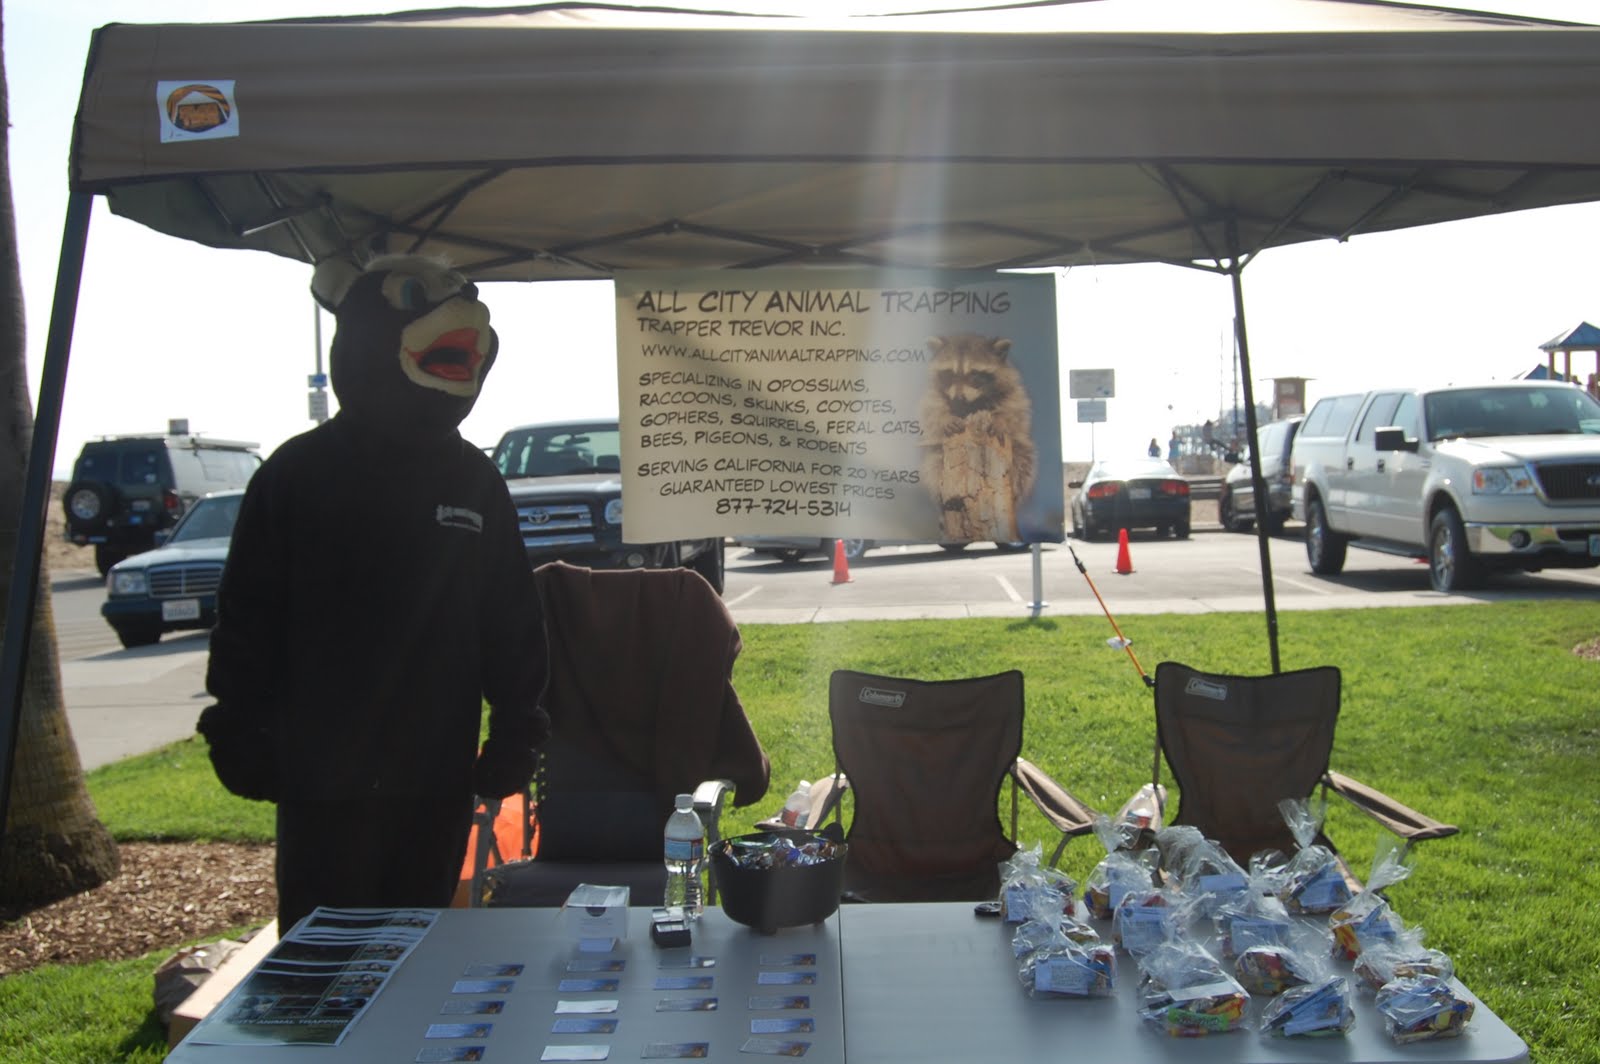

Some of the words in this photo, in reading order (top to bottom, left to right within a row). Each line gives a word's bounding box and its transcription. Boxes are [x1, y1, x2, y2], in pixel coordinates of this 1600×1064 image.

[636, 290, 688, 313] ALL
[698, 290, 758, 313] CITY
[764, 290, 871, 313] ANIMAL
[880, 291, 1012, 314] TRAPPING
[637, 317, 721, 336] TRAPPER
[728, 320, 804, 336] TREVOR
[810, 320, 846, 337] INC.
[641, 344, 925, 364] WWW.ALLCITYANIMALTRAPPING.COM
[639, 371, 742, 389] SPECIALIZING
[748, 379, 762, 392] IN
[767, 379, 870, 393] OPOSSUMS,
[639, 391, 737, 407] RACCOONS,
[743, 397, 809, 414] SKUNKS,
[816, 400, 897, 415] COYOTES,
[640, 411, 724, 427] GOPHERS,
[730, 413, 820, 435] SQUIRRELS,
[826, 420, 875, 434] FERAL
[882, 420, 924, 436] CATS,
[641, 432, 687, 448] BEES,
[694, 431, 773, 447] PIGEONS,
[779, 435, 791, 447] &
[797, 438, 867, 455] RODENTS
[637, 458, 708, 477] SERVING
[714, 458, 805, 474] CALIFORNIA
[811, 463, 842, 476] FOR
[847, 467, 867, 479] 20
[872, 470, 920, 484] YEARS
[660, 479, 765, 496] GUARANTEED
[770, 480, 838, 495] LOWEST
[842, 484, 895, 499] PRICES
[715, 498, 851, 517] 877-724-5314
